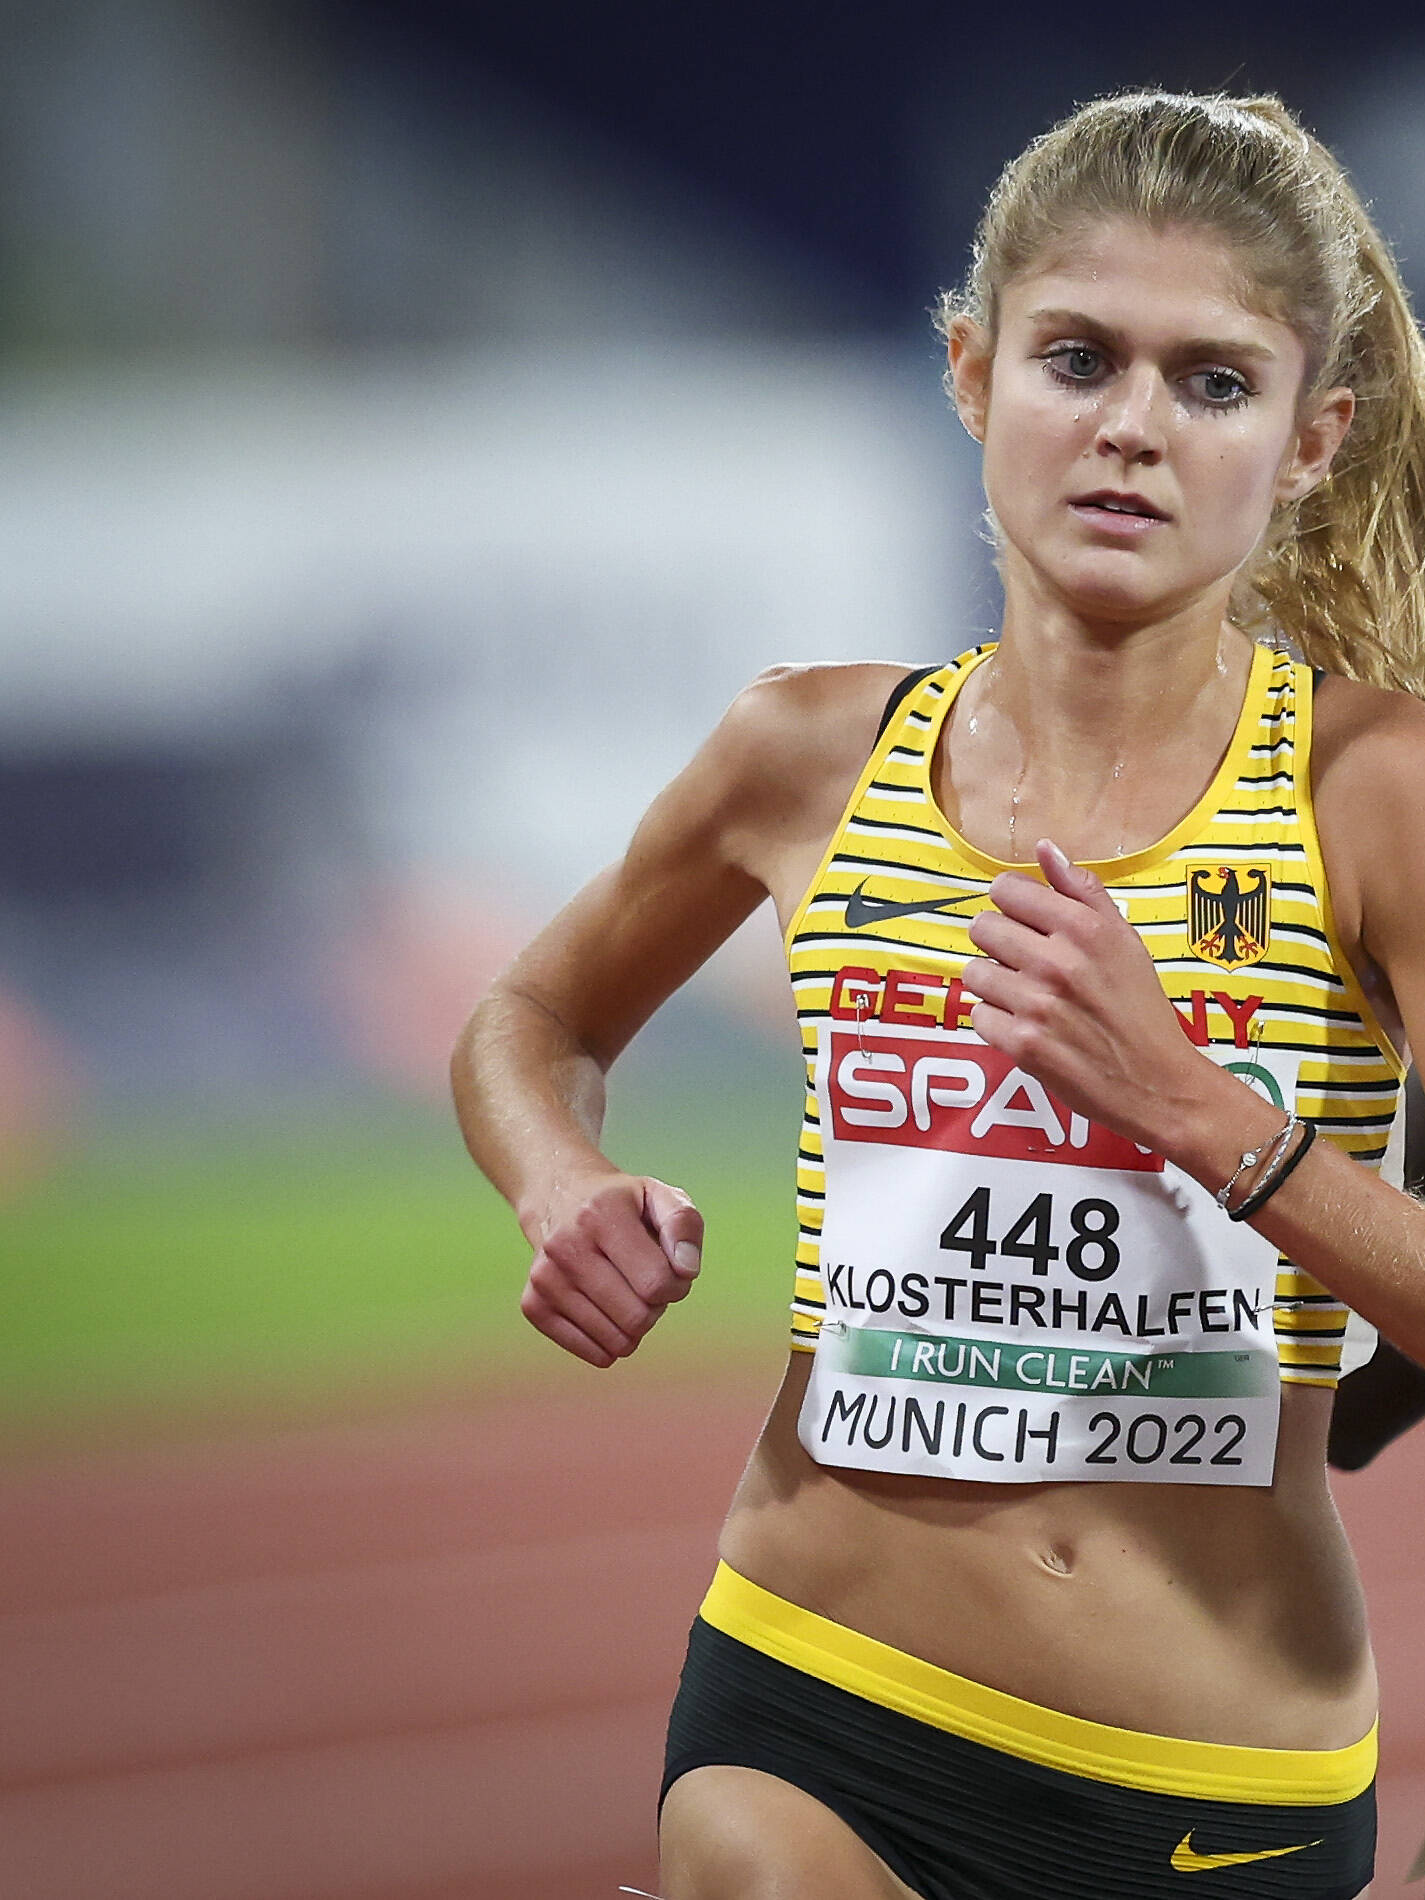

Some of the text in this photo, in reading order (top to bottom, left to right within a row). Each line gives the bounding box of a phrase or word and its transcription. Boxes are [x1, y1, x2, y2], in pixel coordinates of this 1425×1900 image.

[837, 1052, 1153, 1155] SPA
[940, 1186, 1120, 1282] 448
[826, 1262, 1261, 1338] KLOSTERHALFEN
[890, 1338, 903, 1372] I
[912, 1341, 1001, 1383] RUN
[821, 1389, 1247, 1465] MUNICH 2022
